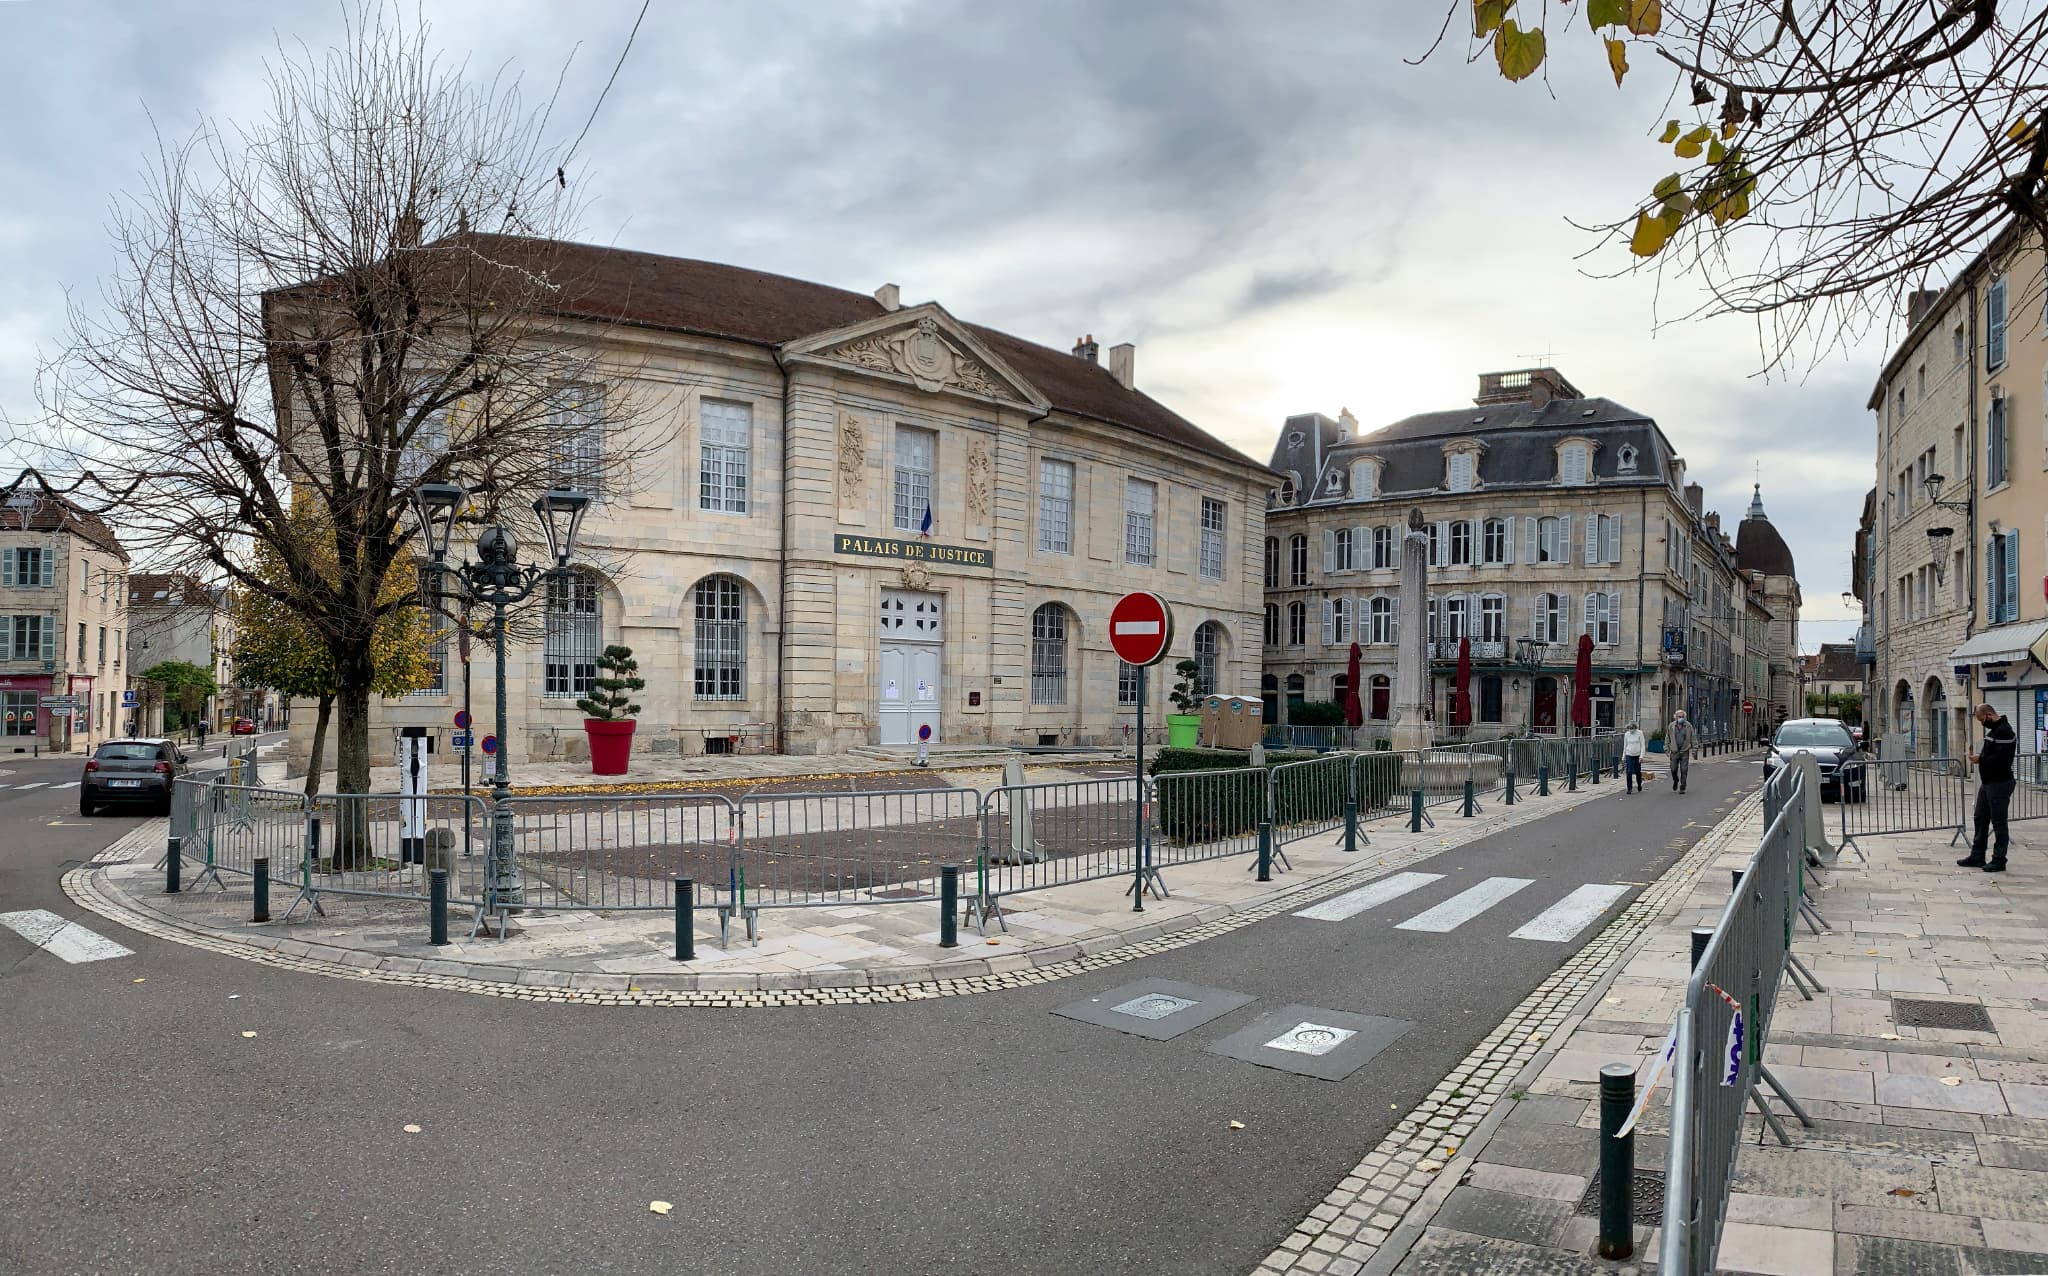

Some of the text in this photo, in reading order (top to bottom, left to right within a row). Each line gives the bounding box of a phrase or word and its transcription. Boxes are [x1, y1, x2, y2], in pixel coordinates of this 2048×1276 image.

[842, 538, 985, 564] PALAIS DE JUSTICE
